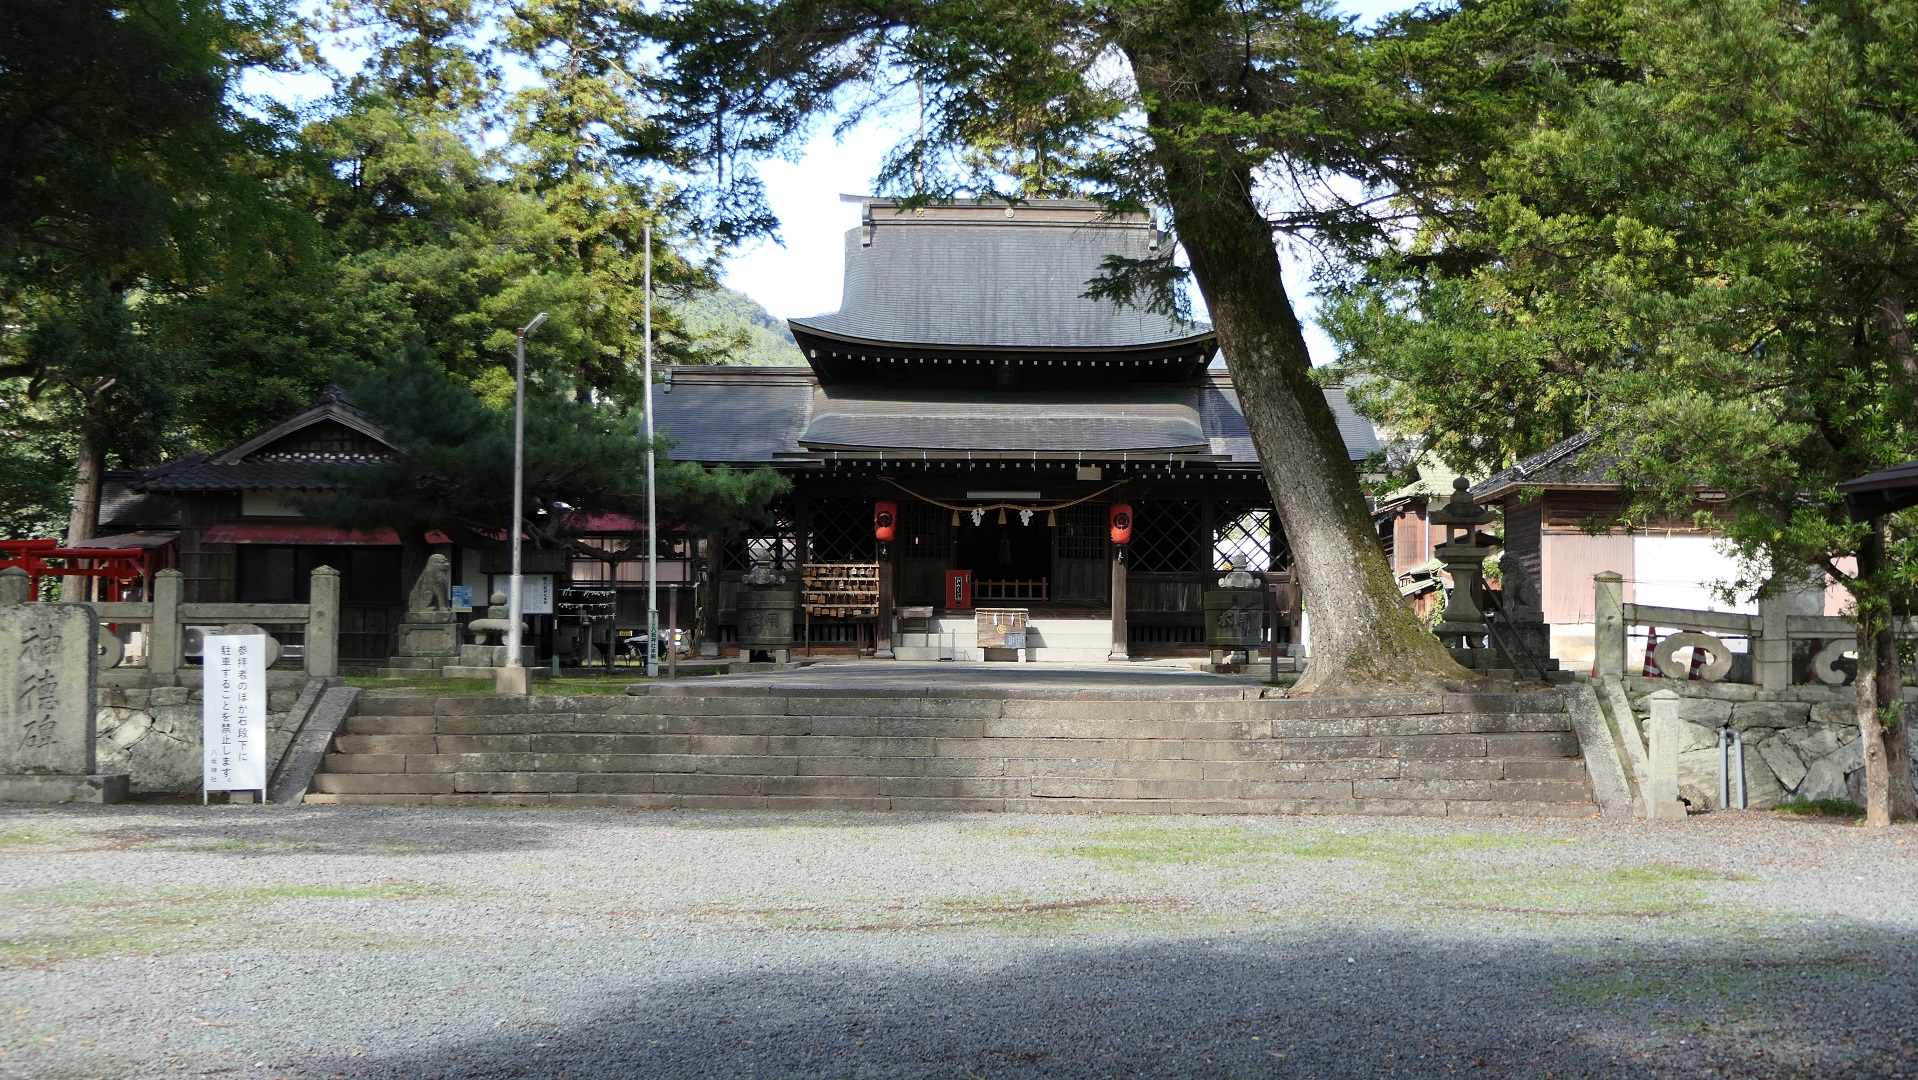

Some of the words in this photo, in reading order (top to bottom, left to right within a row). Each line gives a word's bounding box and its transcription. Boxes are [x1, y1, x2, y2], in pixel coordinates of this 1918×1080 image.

[238, 645, 248, 761] 参拝者のほか石段下に
